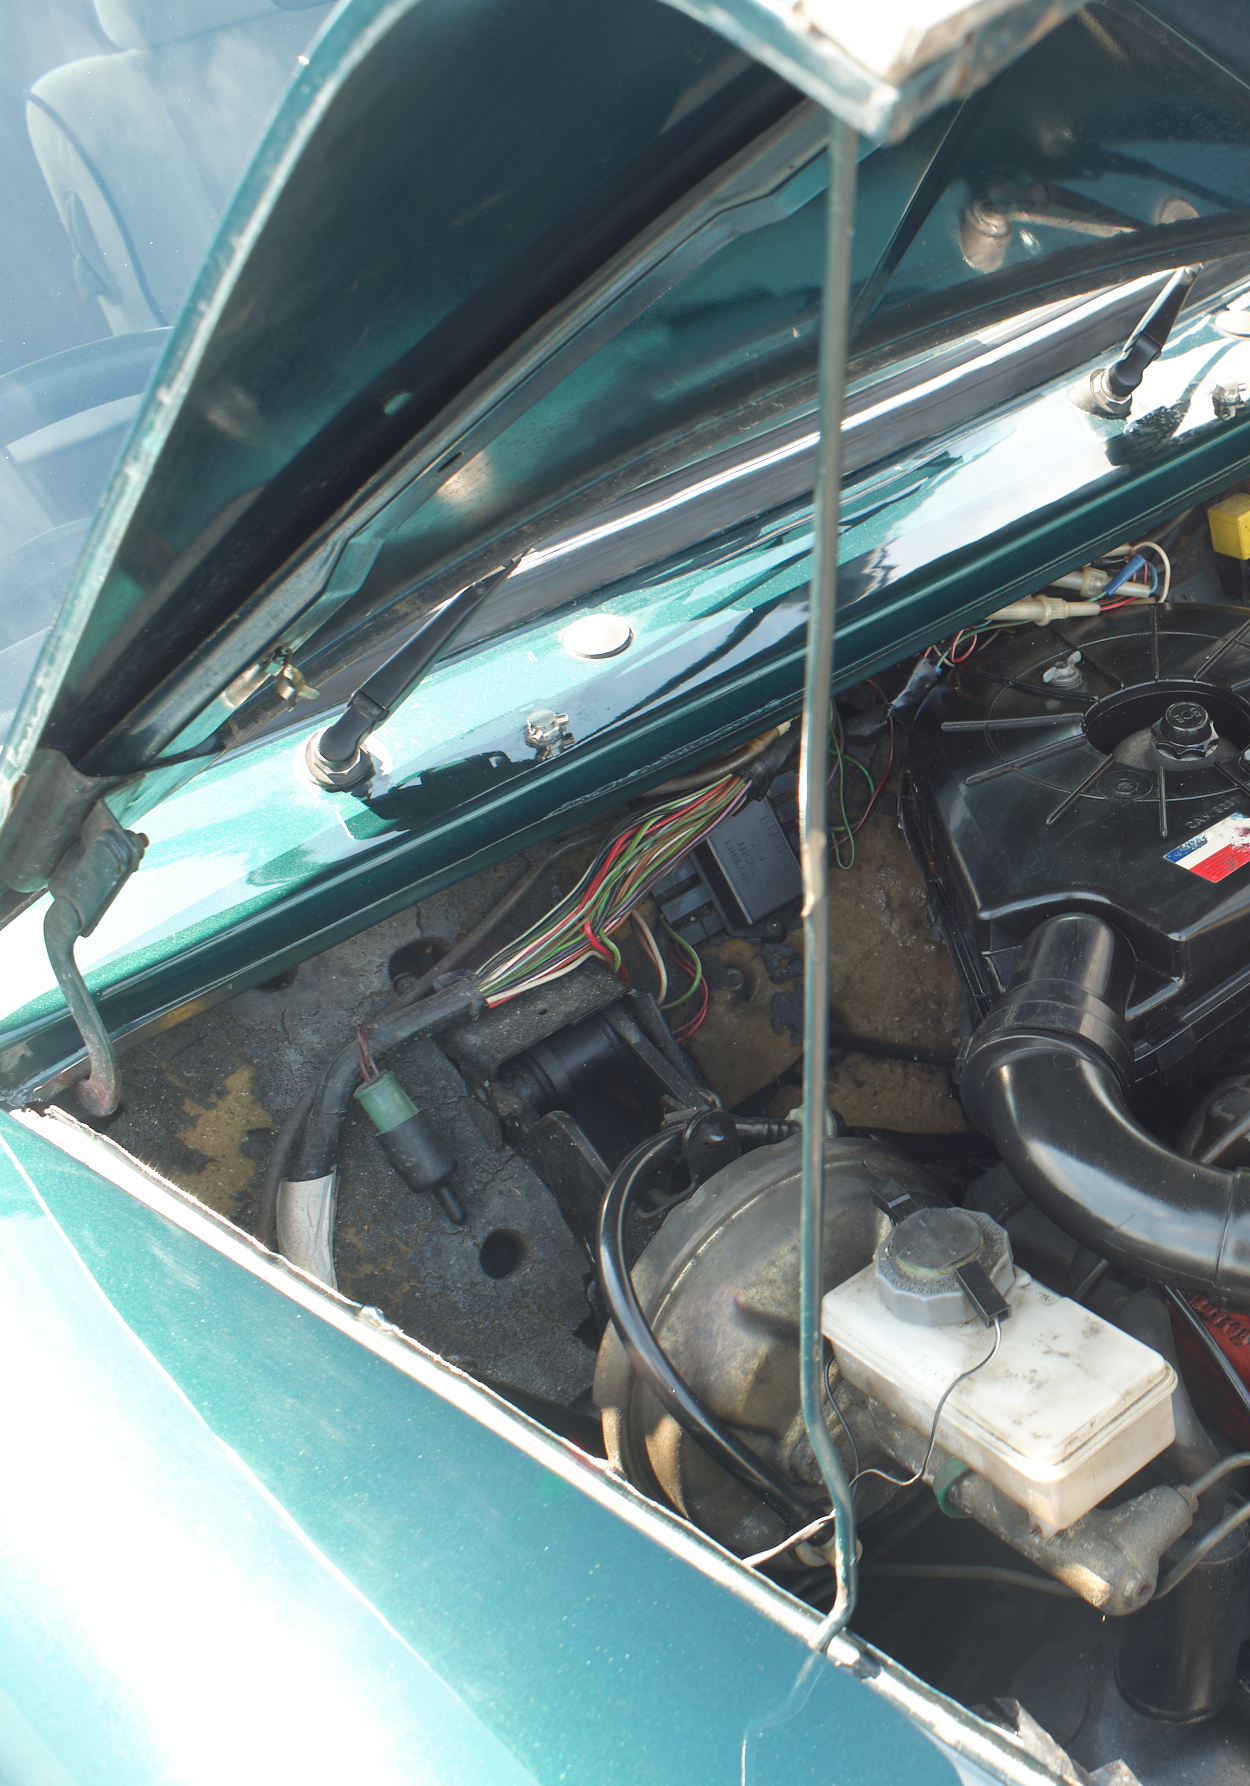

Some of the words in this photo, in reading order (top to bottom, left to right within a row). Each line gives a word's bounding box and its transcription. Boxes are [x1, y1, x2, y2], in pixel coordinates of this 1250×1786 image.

[724, 838, 753, 887] ENGLAND
[738, 841, 759, 875] LUCAS
[760, 814, 793, 870] FUSES
